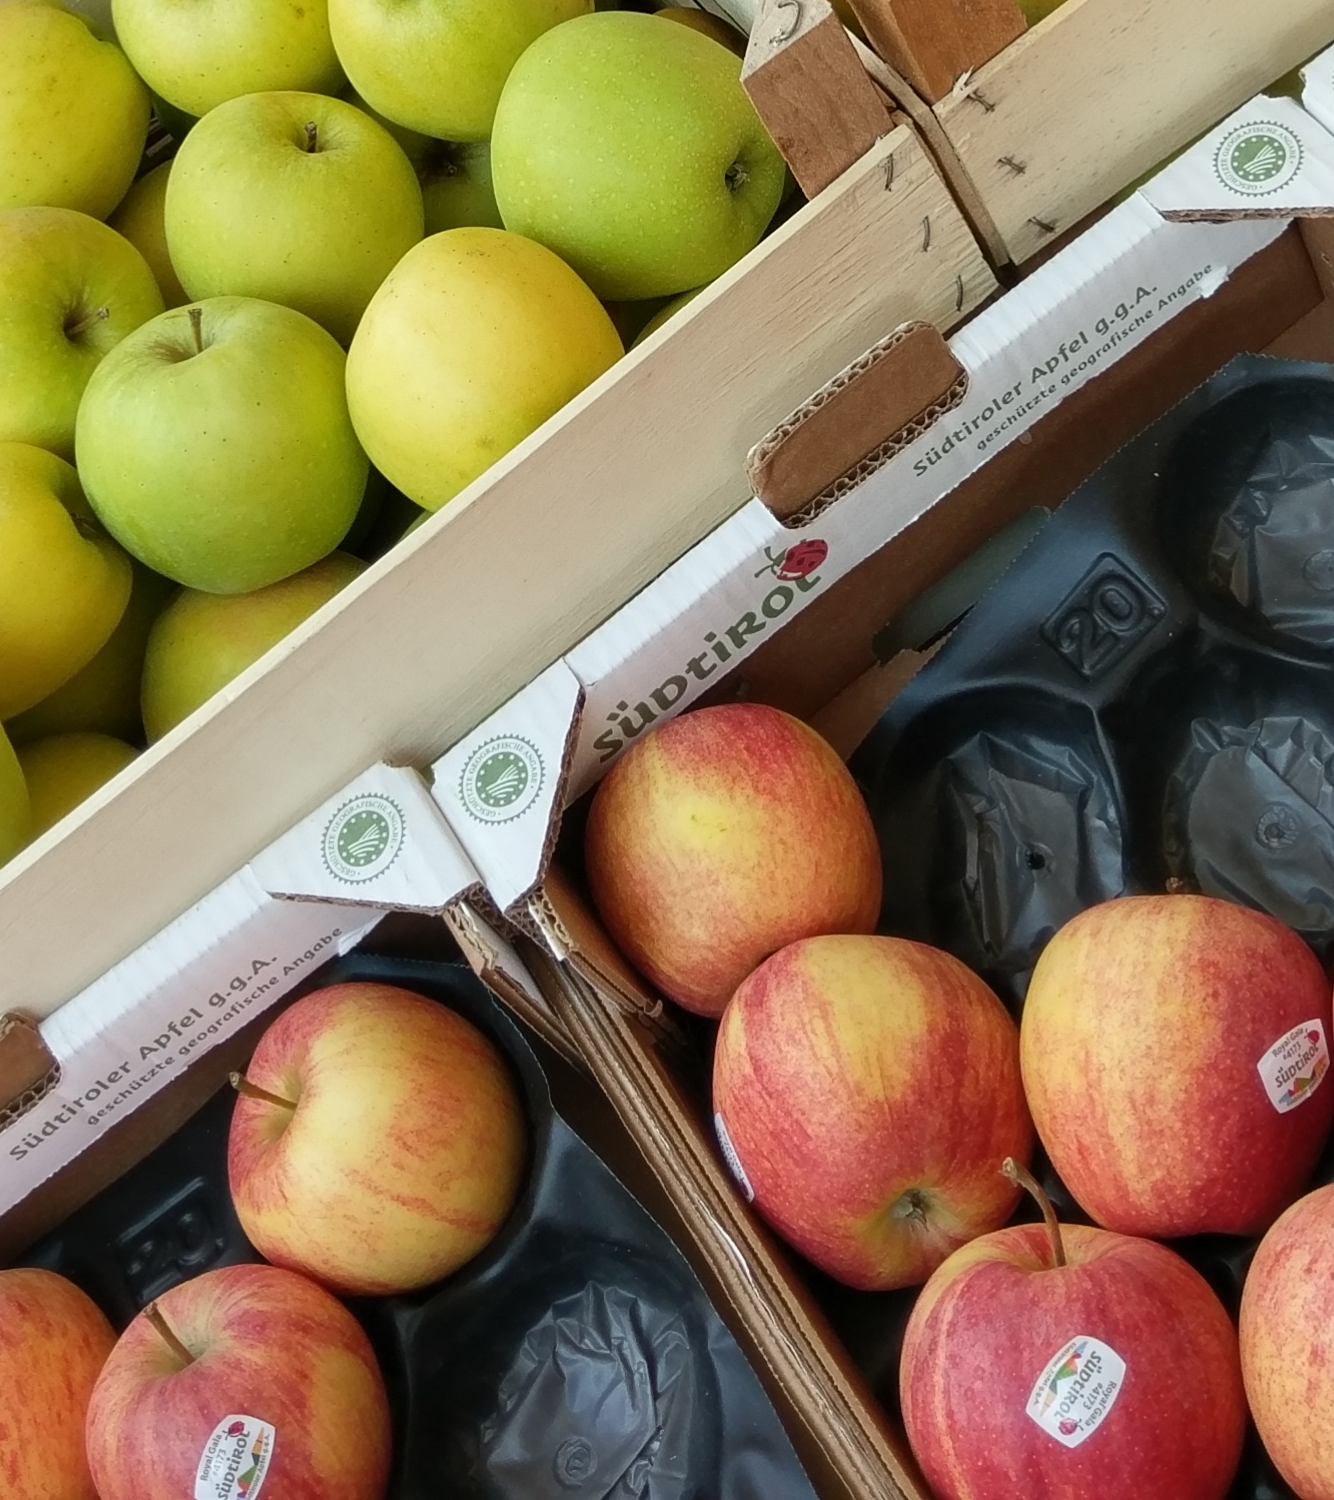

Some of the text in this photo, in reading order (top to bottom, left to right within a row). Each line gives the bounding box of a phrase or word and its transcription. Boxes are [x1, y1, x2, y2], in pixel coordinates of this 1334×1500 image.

[977, 264, 1211, 450] geschützte geografische Angabe
[913, 286, 1157, 476] Südtiroler Apfel g.g.A.
[87, 928, 342, 1125] geschützte geografische Angabe
[1271, 1027, 1303, 1057] Royal Gala
[9, 956, 277, 1160] Südtiroler Apfel g.g.A.
[1082, 1382, 1103, 1410] #4173
[1084, 1380, 1117, 1426] Royal Gala
[199, 1434, 222, 1481] Royal Gala
[212, 1448, 226, 1475] #4173
